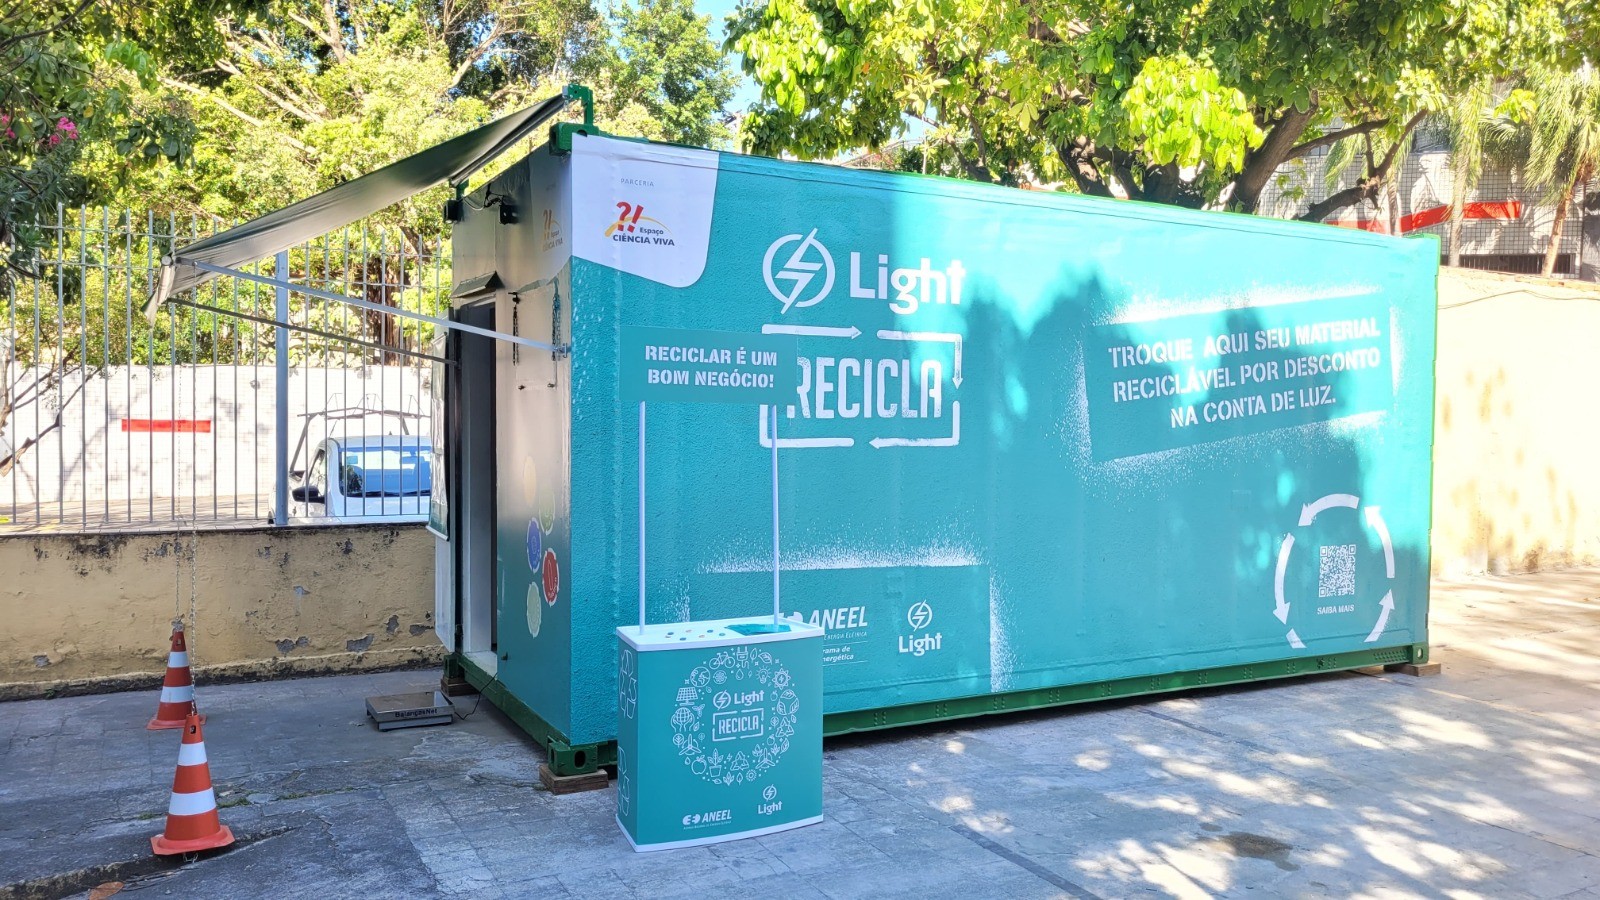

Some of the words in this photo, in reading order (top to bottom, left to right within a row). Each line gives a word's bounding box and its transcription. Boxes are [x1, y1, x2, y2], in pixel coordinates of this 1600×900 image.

[620, 178, 655, 187] PARCERIA
[612, 233, 651, 244] CIÊNCIA
[653, 237, 676, 246] VIVA
[639, 227, 664, 236] Espaço
[850, 251, 967, 315] Light
[1108, 338, 1194, 368] TROQUE
[1203, 331, 1249, 356] AQUI
[1254, 327, 1291, 350] SEU
[1295, 316, 1381, 345] MATERIAL
[645, 345, 732, 364] RECICLAR
[736, 346, 747, 365] É
[751, 350, 777, 367] UM
[647, 368, 690, 385] BOM
[694, 368, 774, 388] NEGÓCIO!
[1113, 364, 1236, 403] RECICLÁVEL
[1240, 360, 1279, 385] POR
[1284, 346, 1381, 379] DESCONTO
[796, 356, 942, 419] RECICLA
[1170, 407, 1199, 429] NA
[1203, 394, 1267, 423] CONTA
[1271, 389, 1296, 412] DE
[1300, 384, 1337, 408] LUZ.
[808, 606, 868, 630] ANEEL
[1316, 605, 1338, 615] SAIBA
[1338, 604, 1355, 613] MAIS
[841, 645, 851, 653] de
[898, 632, 943, 656] Light
[822, 653, 855, 663] nergética
[733, 690, 765, 707] Light
[718, 715, 759, 735] RECICLA
[701, 809, 732, 823] ANEEL
[757, 801, 783, 815] Light
